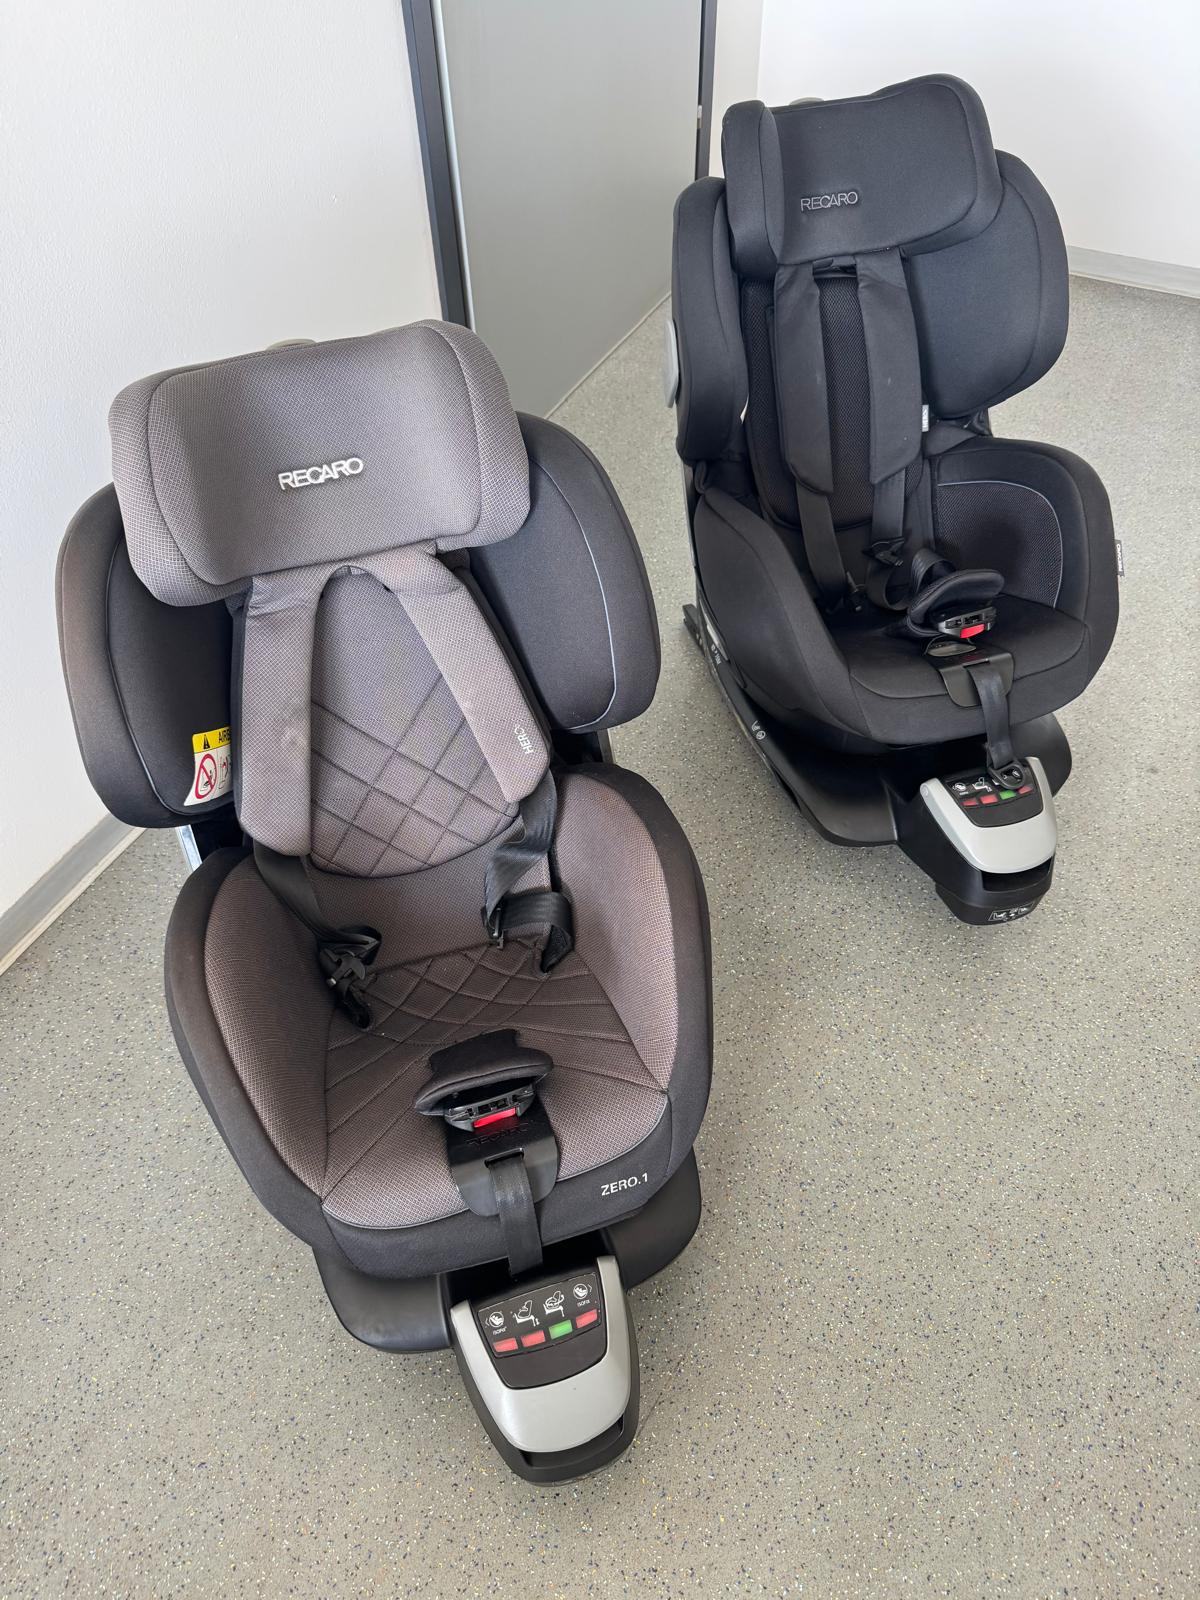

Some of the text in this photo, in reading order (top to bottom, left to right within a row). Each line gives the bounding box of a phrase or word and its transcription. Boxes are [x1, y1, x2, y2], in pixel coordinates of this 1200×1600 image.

[800, 191, 858, 212] RECARO
[278, 457, 364, 490] RECARO
[600, 1172, 648, 1196] ZERO.1
